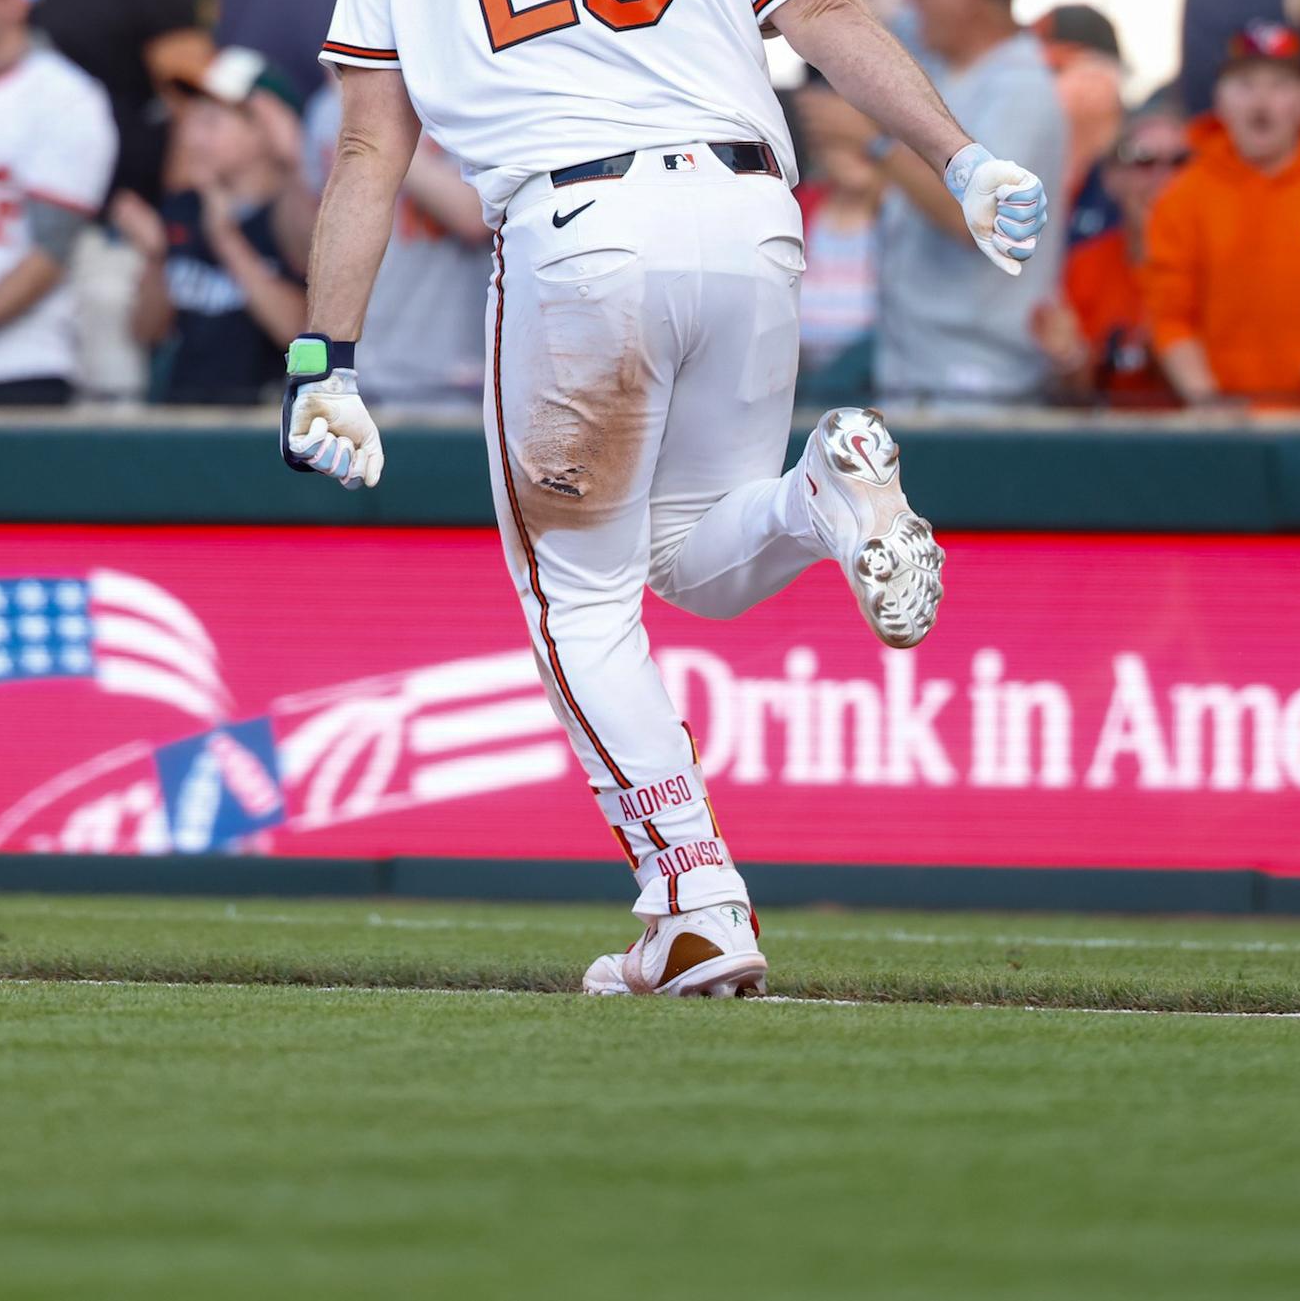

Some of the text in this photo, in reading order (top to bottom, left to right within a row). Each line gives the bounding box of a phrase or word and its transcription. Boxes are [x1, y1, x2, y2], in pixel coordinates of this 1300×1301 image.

[655, 646, 958, 787] Drink
[967, 647, 1075, 789] in
[618, 774, 692, 822] ALONSO
